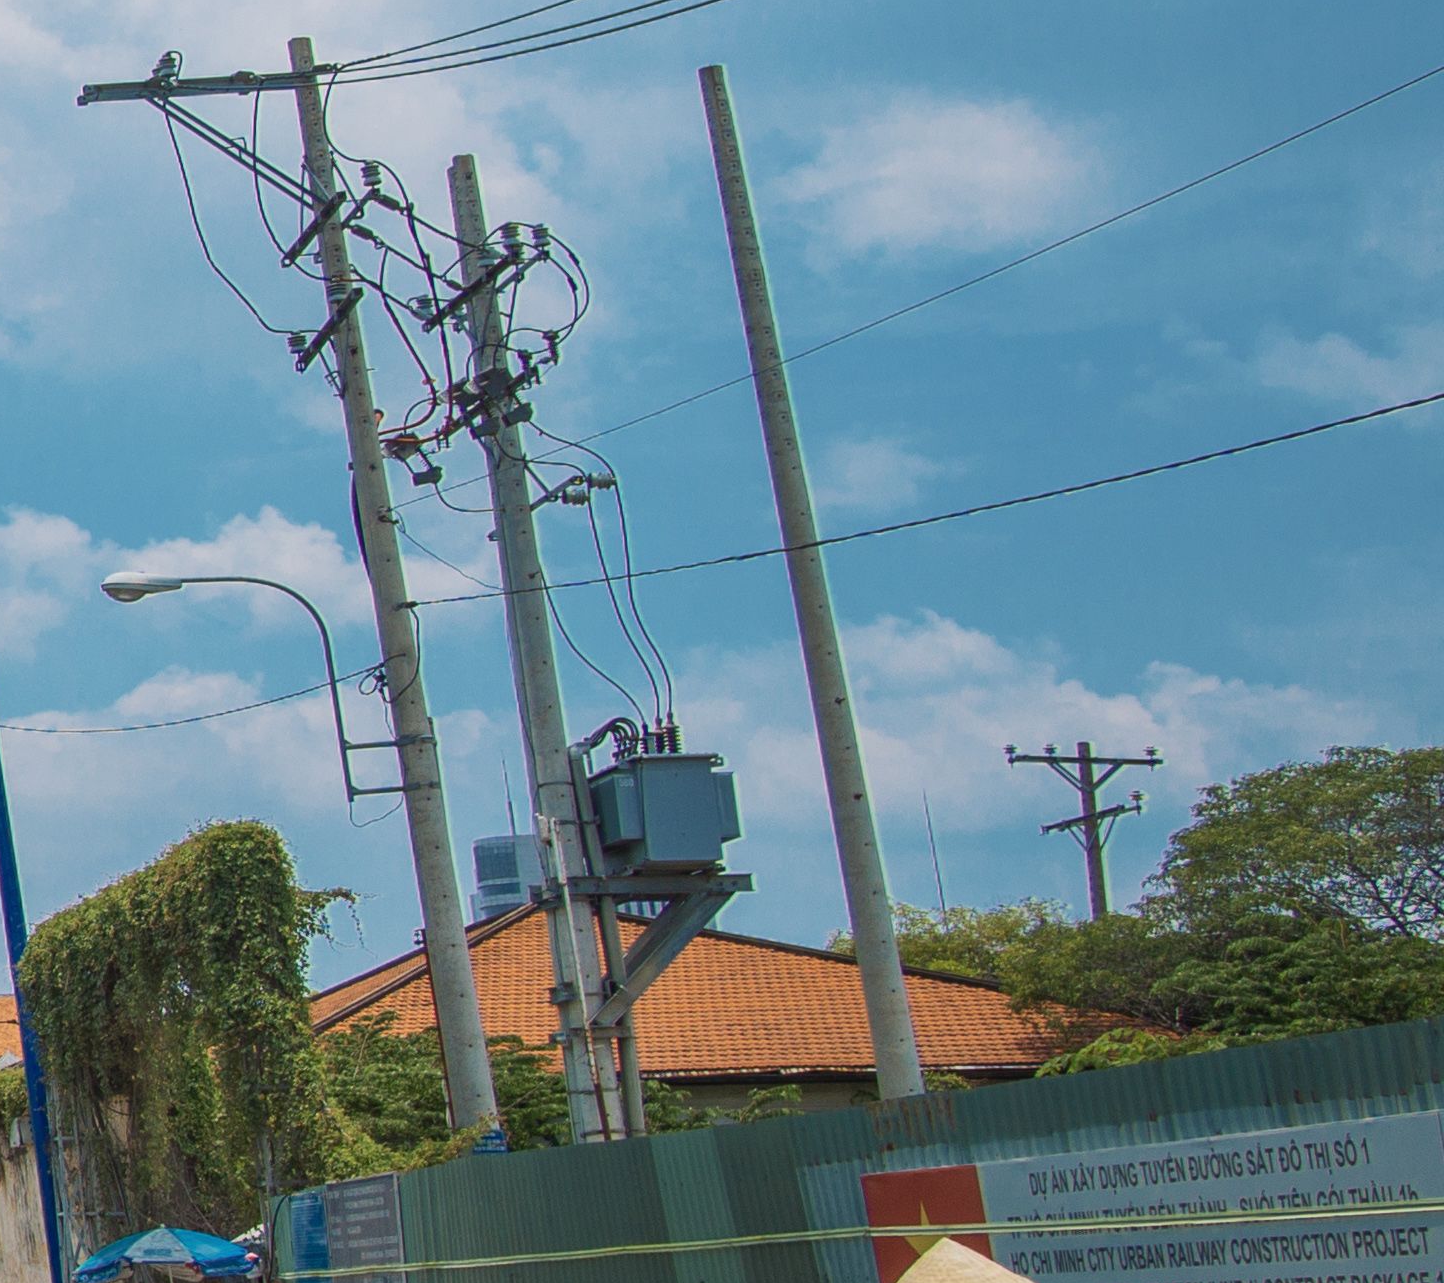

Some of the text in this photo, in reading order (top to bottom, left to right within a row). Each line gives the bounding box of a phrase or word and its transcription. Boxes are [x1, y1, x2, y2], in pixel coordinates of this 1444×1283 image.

[1029, 1171, 1047, 1201] DỰ
[1052, 1165, 1068, 1194] ÁN
[1069, 1162, 1095, 1192] XÂY
[1098, 1162, 1138, 1195] DỰNG
[1139, 1151, 1187, 1186] TUYẾN
[1188, 1148, 1244, 1181] ĐƯỜNG
[1278, 1139, 1302, 1173] ĐÔ
[1304, 1142, 1332, 1176] THỊ
[1333, 1132, 1357, 1167] SỐ
[1361, 1137, 1370, 1165] 1
[1010, 1226, 1429, 1275] HO CHI MINH CITY URBAN RAILWAY CONSTRUCTION PROJECT
